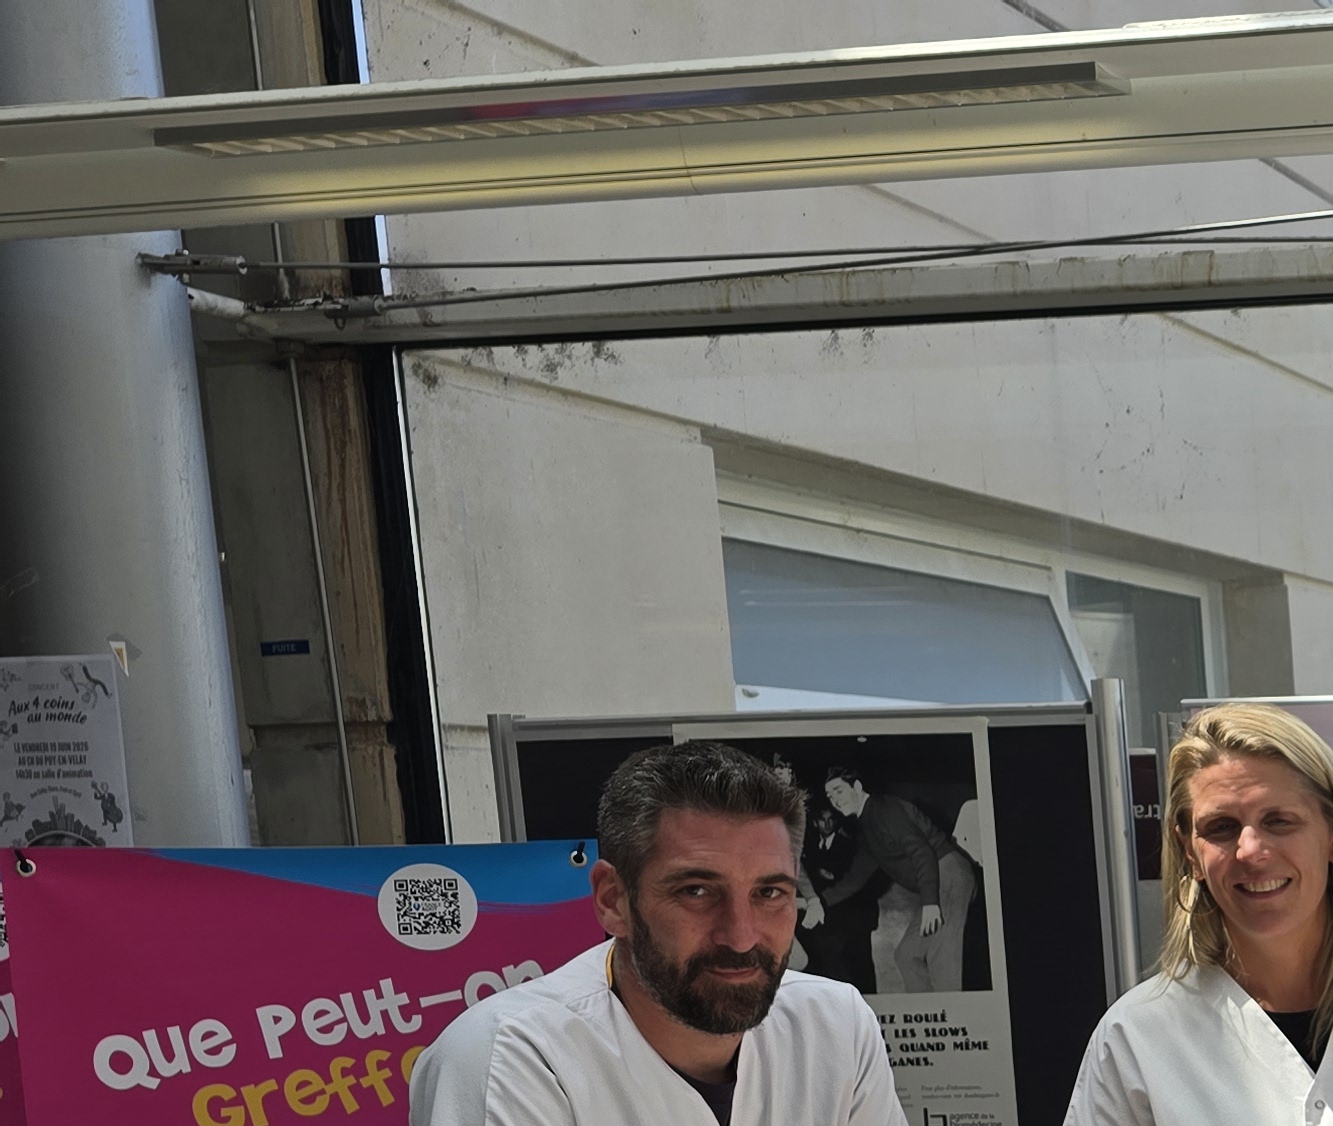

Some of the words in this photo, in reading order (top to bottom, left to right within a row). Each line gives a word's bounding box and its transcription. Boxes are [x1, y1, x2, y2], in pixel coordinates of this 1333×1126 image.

[271, 643, 297, 653] FUITE
[8, 699, 30, 718] Aux
[32, 695, 40, 711] 4
[43, 695, 75, 711] coins
[27, 712, 41, 724] au
[45, 711, 88, 725] monde
[903, 1008, 948, 1024] ROULÉ
[895, 1027, 916, 1039] LES
[924, 1026, 968, 1038] SLOWS
[900, 1041, 946, 1053] QUAND
[953, 1038, 990, 1051] MÊME
[92, 1018, 237, 1090] Que
